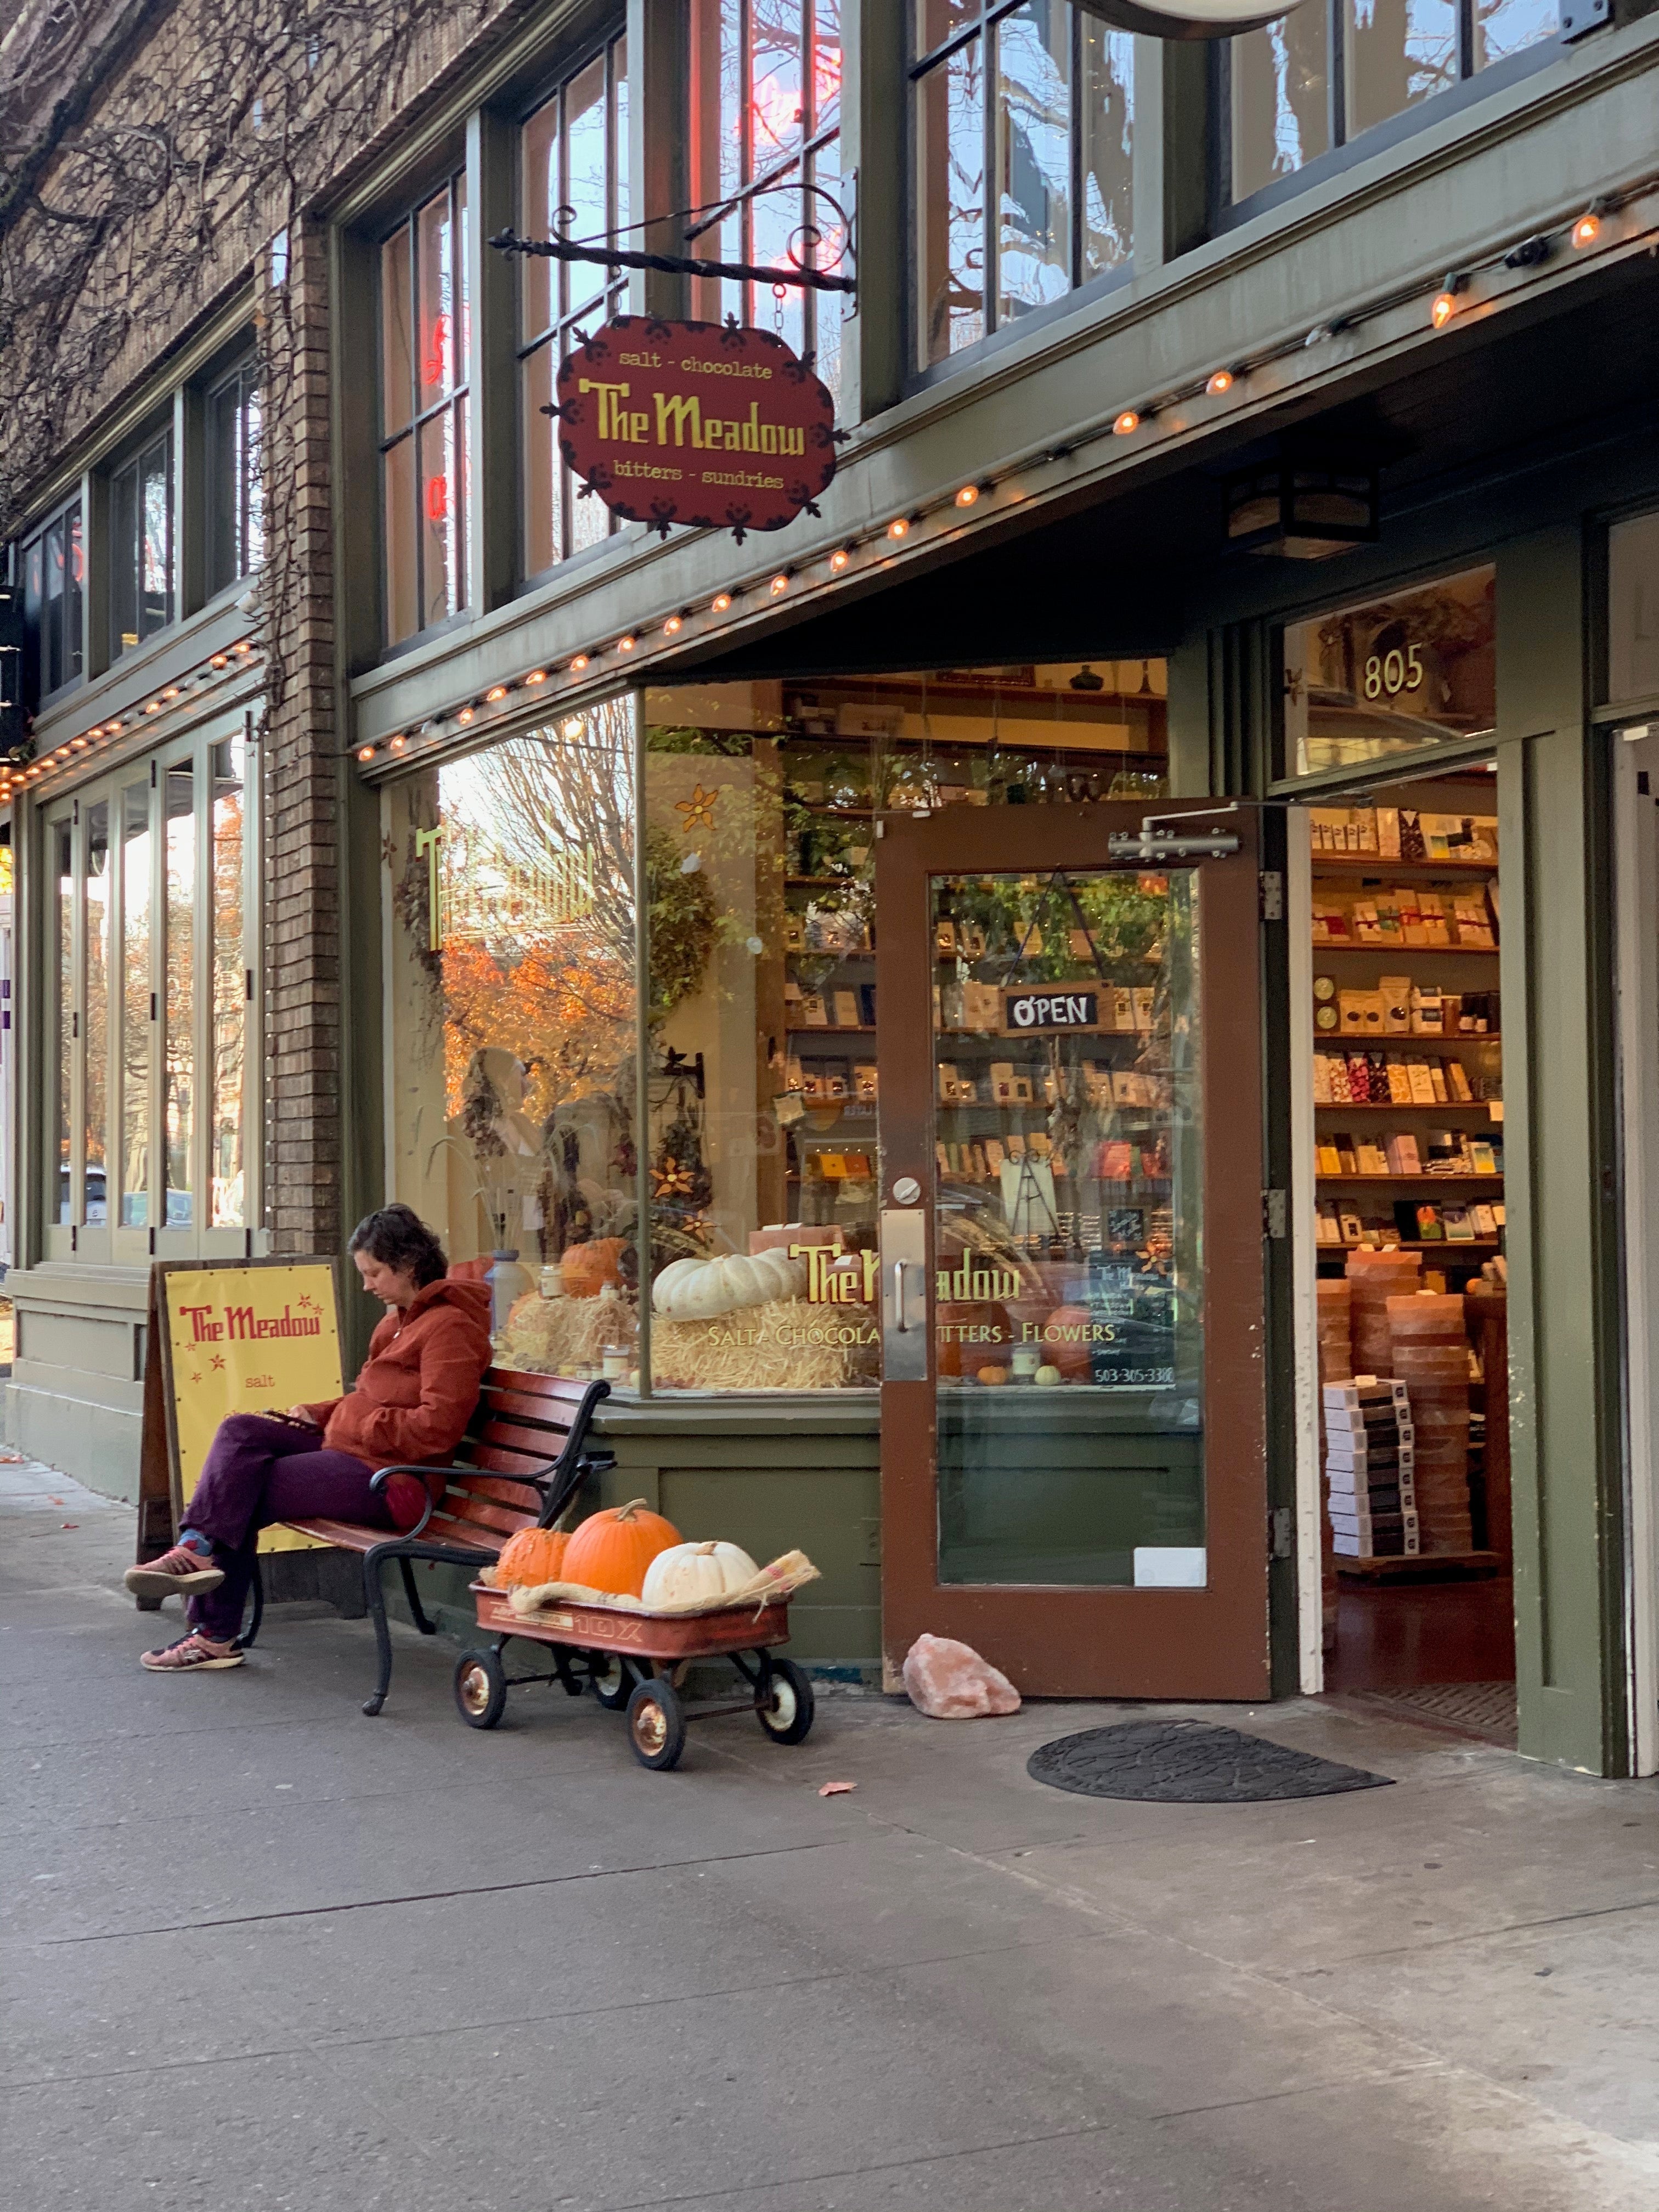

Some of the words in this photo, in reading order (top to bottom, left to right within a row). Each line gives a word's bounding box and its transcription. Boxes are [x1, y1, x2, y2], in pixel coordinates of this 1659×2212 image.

[619, 351, 662, 369] salt
[681, 357, 772, 380] chocolate
[579, 378, 648, 444] The
[653, 392, 805, 456] Meadow
[613, 460, 682, 481] bitters
[702, 471, 784, 489] sundries
[1364, 642, 1423, 699] 805
[1013, 995, 1087, 1026] OPEN
[789, 1242, 858, 1303] The
[179, 1305, 224, 1342] The
[224, 1305, 321, 1340] Meadow
[775, 1324, 880, 1346] CHOCOLA
[936, 1325, 1002, 1343] TTERS
[245, 1374, 275, 1389] salt
